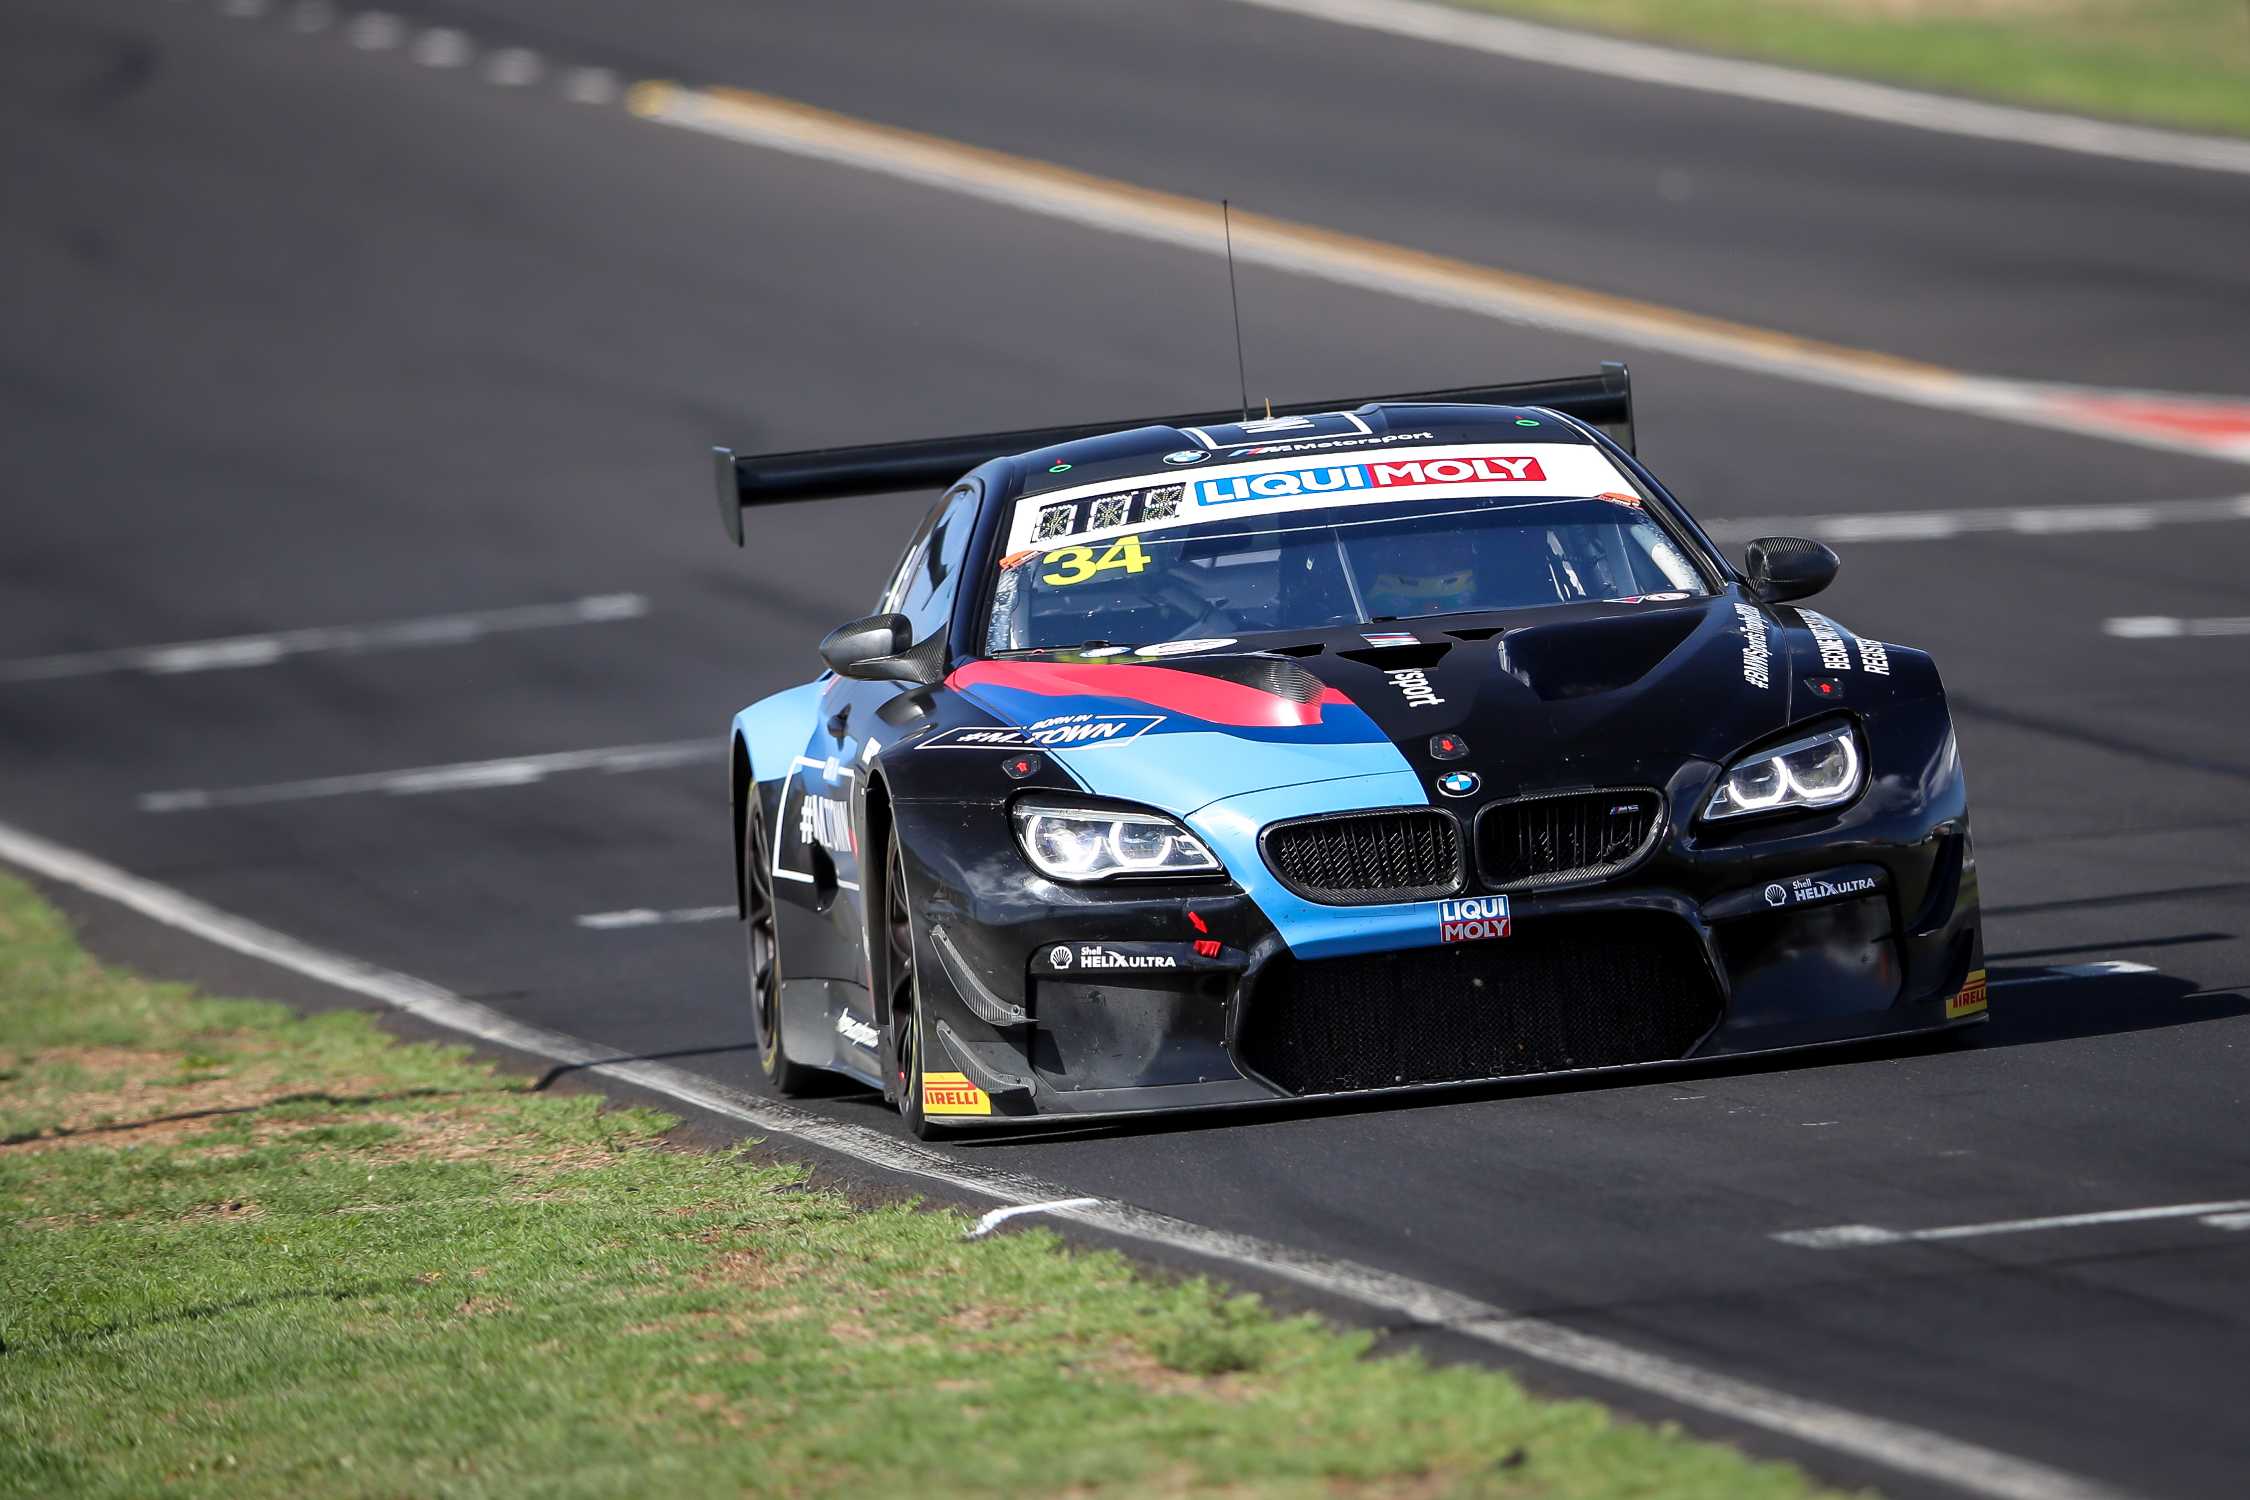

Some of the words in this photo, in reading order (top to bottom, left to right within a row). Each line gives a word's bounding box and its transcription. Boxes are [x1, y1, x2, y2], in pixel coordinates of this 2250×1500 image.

[1293, 431, 1434, 451] Motorsport
[1202, 465, 1364, 503] LIQUI
[1375, 457, 1539, 488] MOLY
[1041, 535, 1151, 587] 34
[1793, 878, 1812, 890] Shell
[1794, 881, 1839, 901] HELIX
[1837, 878, 1875, 893] ULTRA
[1442, 898, 1506, 921] LIQUI
[1444, 920, 1508, 941] MOLY
[1081, 946, 1102, 956] Shell
[1081, 951, 1129, 968] HELIX
[1129, 956, 1177, 968] ULTRA
